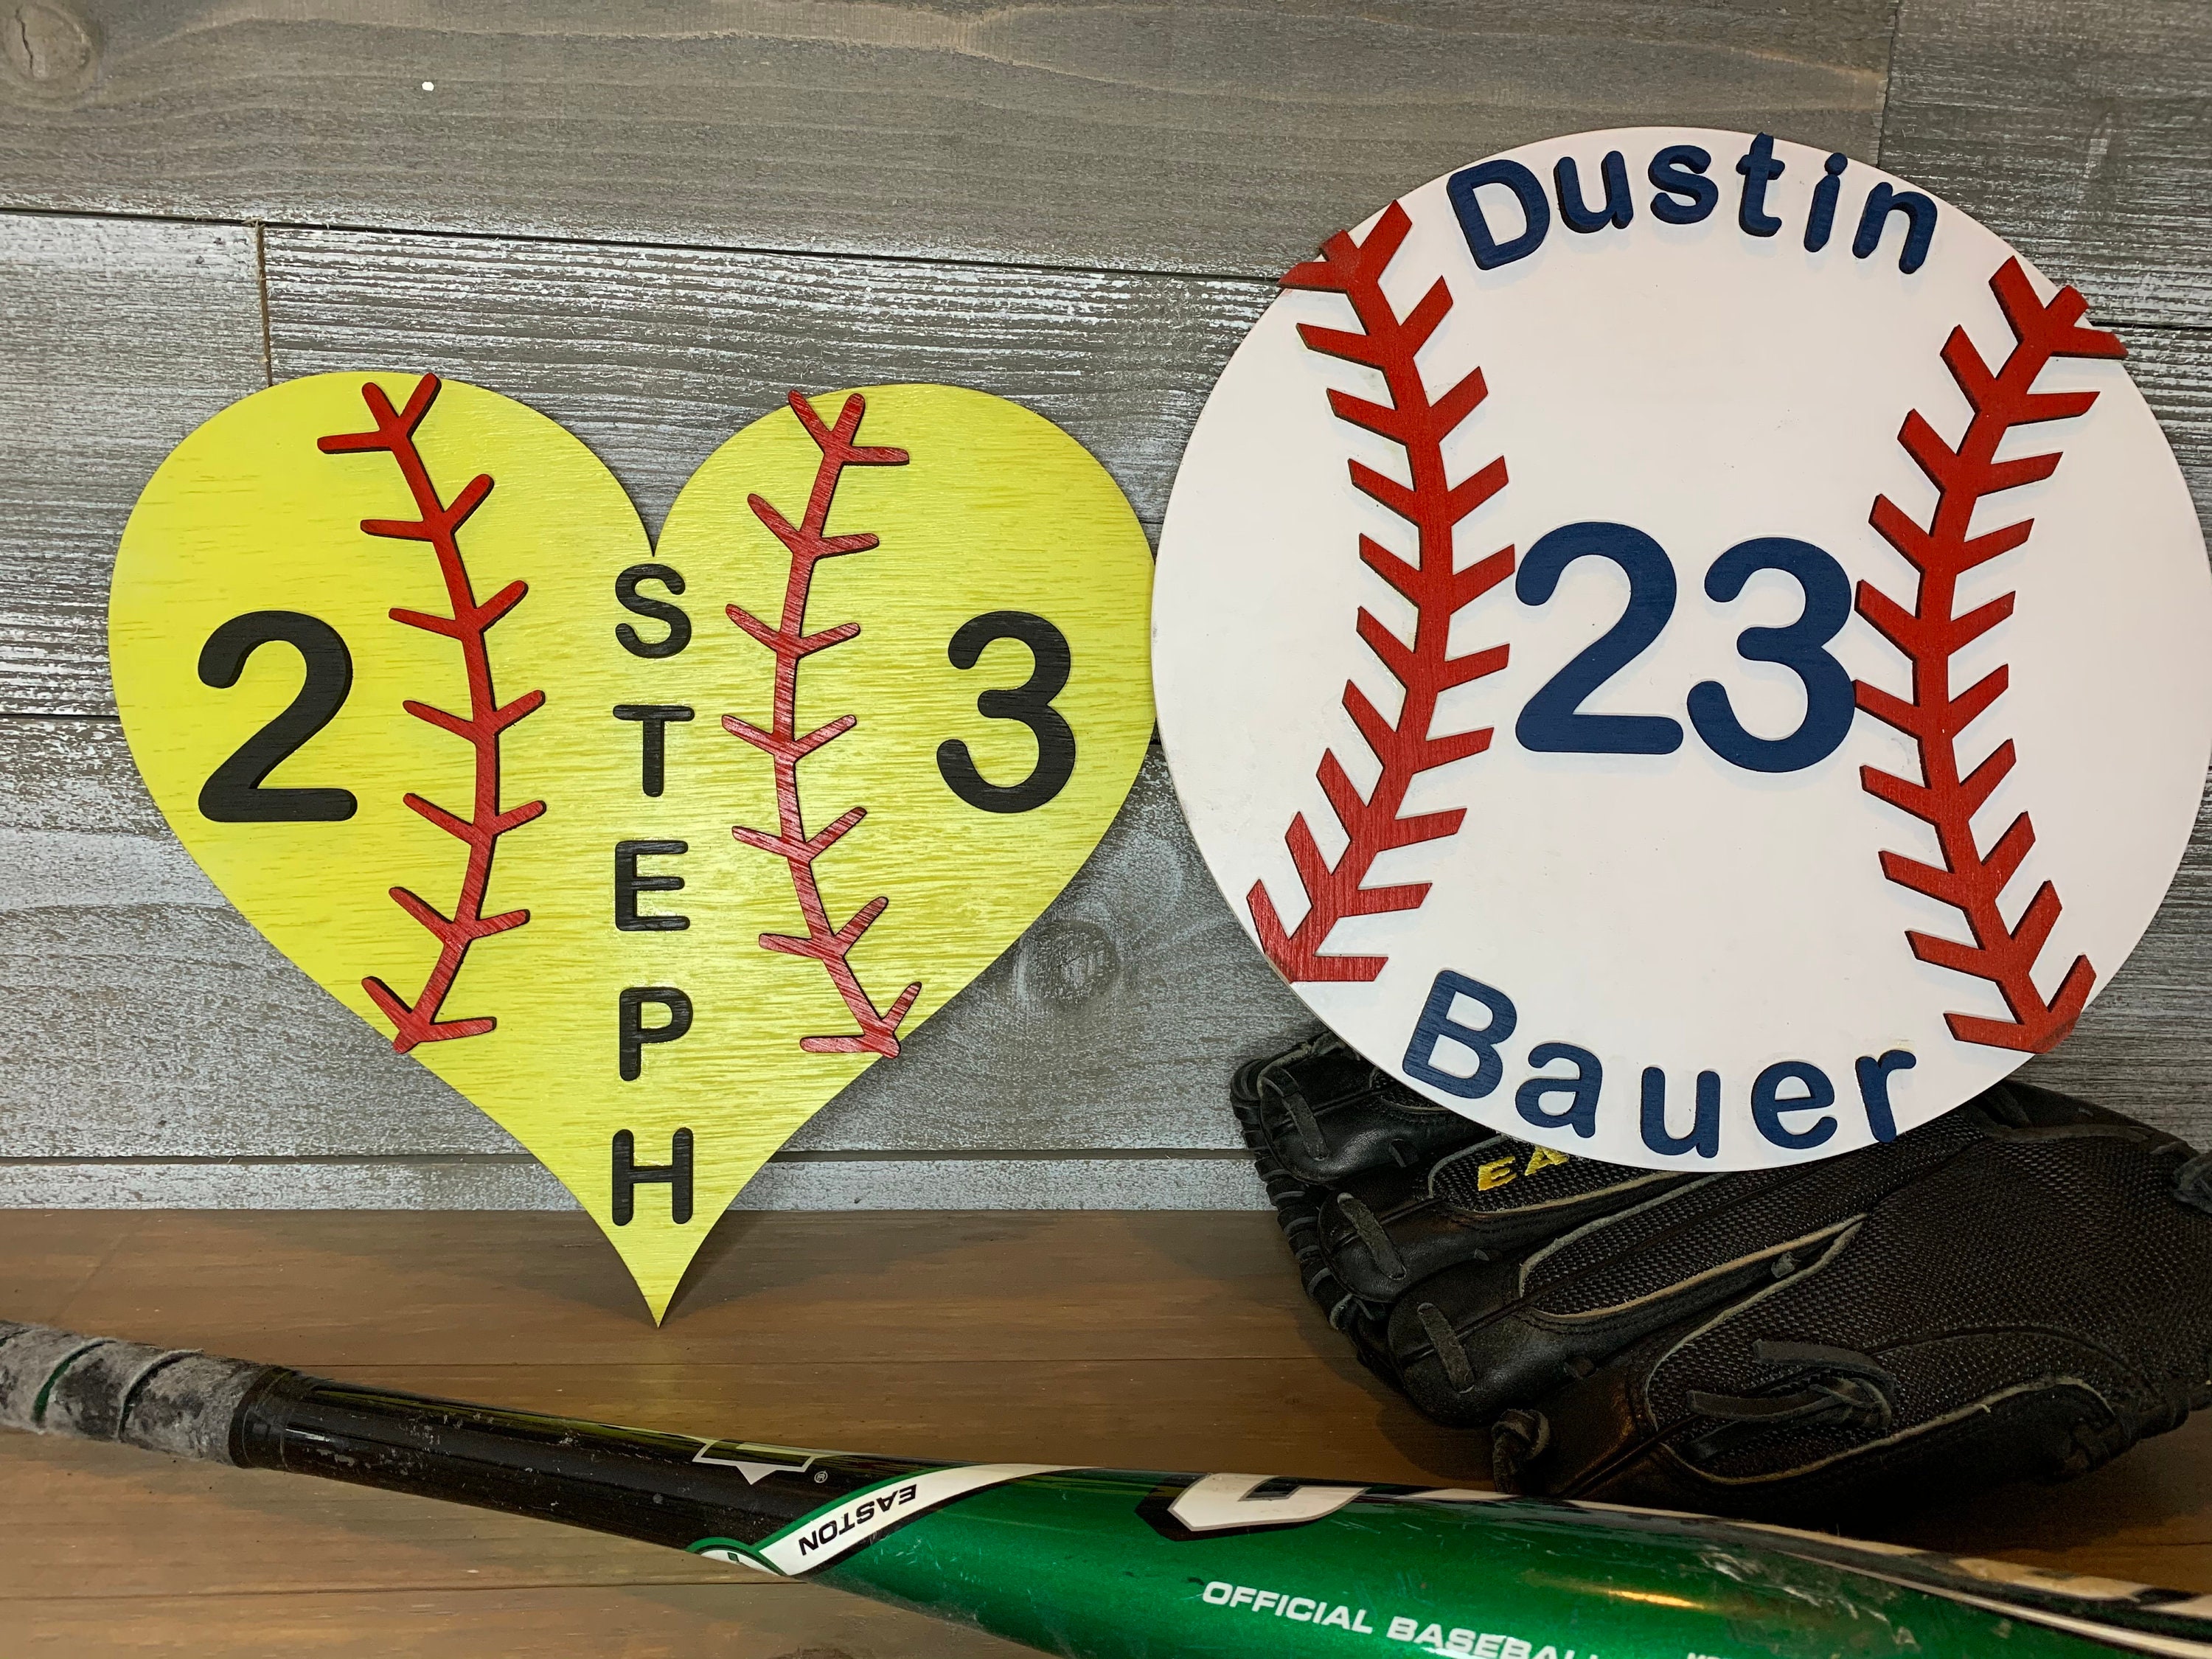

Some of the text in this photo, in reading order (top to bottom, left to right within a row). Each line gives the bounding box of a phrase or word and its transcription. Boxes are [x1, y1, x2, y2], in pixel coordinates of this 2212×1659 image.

[1446, 132, 1938, 274] Dustin
[198, 611, 358, 822] 2
[936, 611, 1076, 813] 3
[1515, 521, 1855, 773] 23
[612, 563, 695, 1227] STEPH
[1402, 970, 1916, 1158] Bauer
[799, 1484, 917, 1556] EASTON
[1203, 1581, 1373, 1634] OFFICIAL
